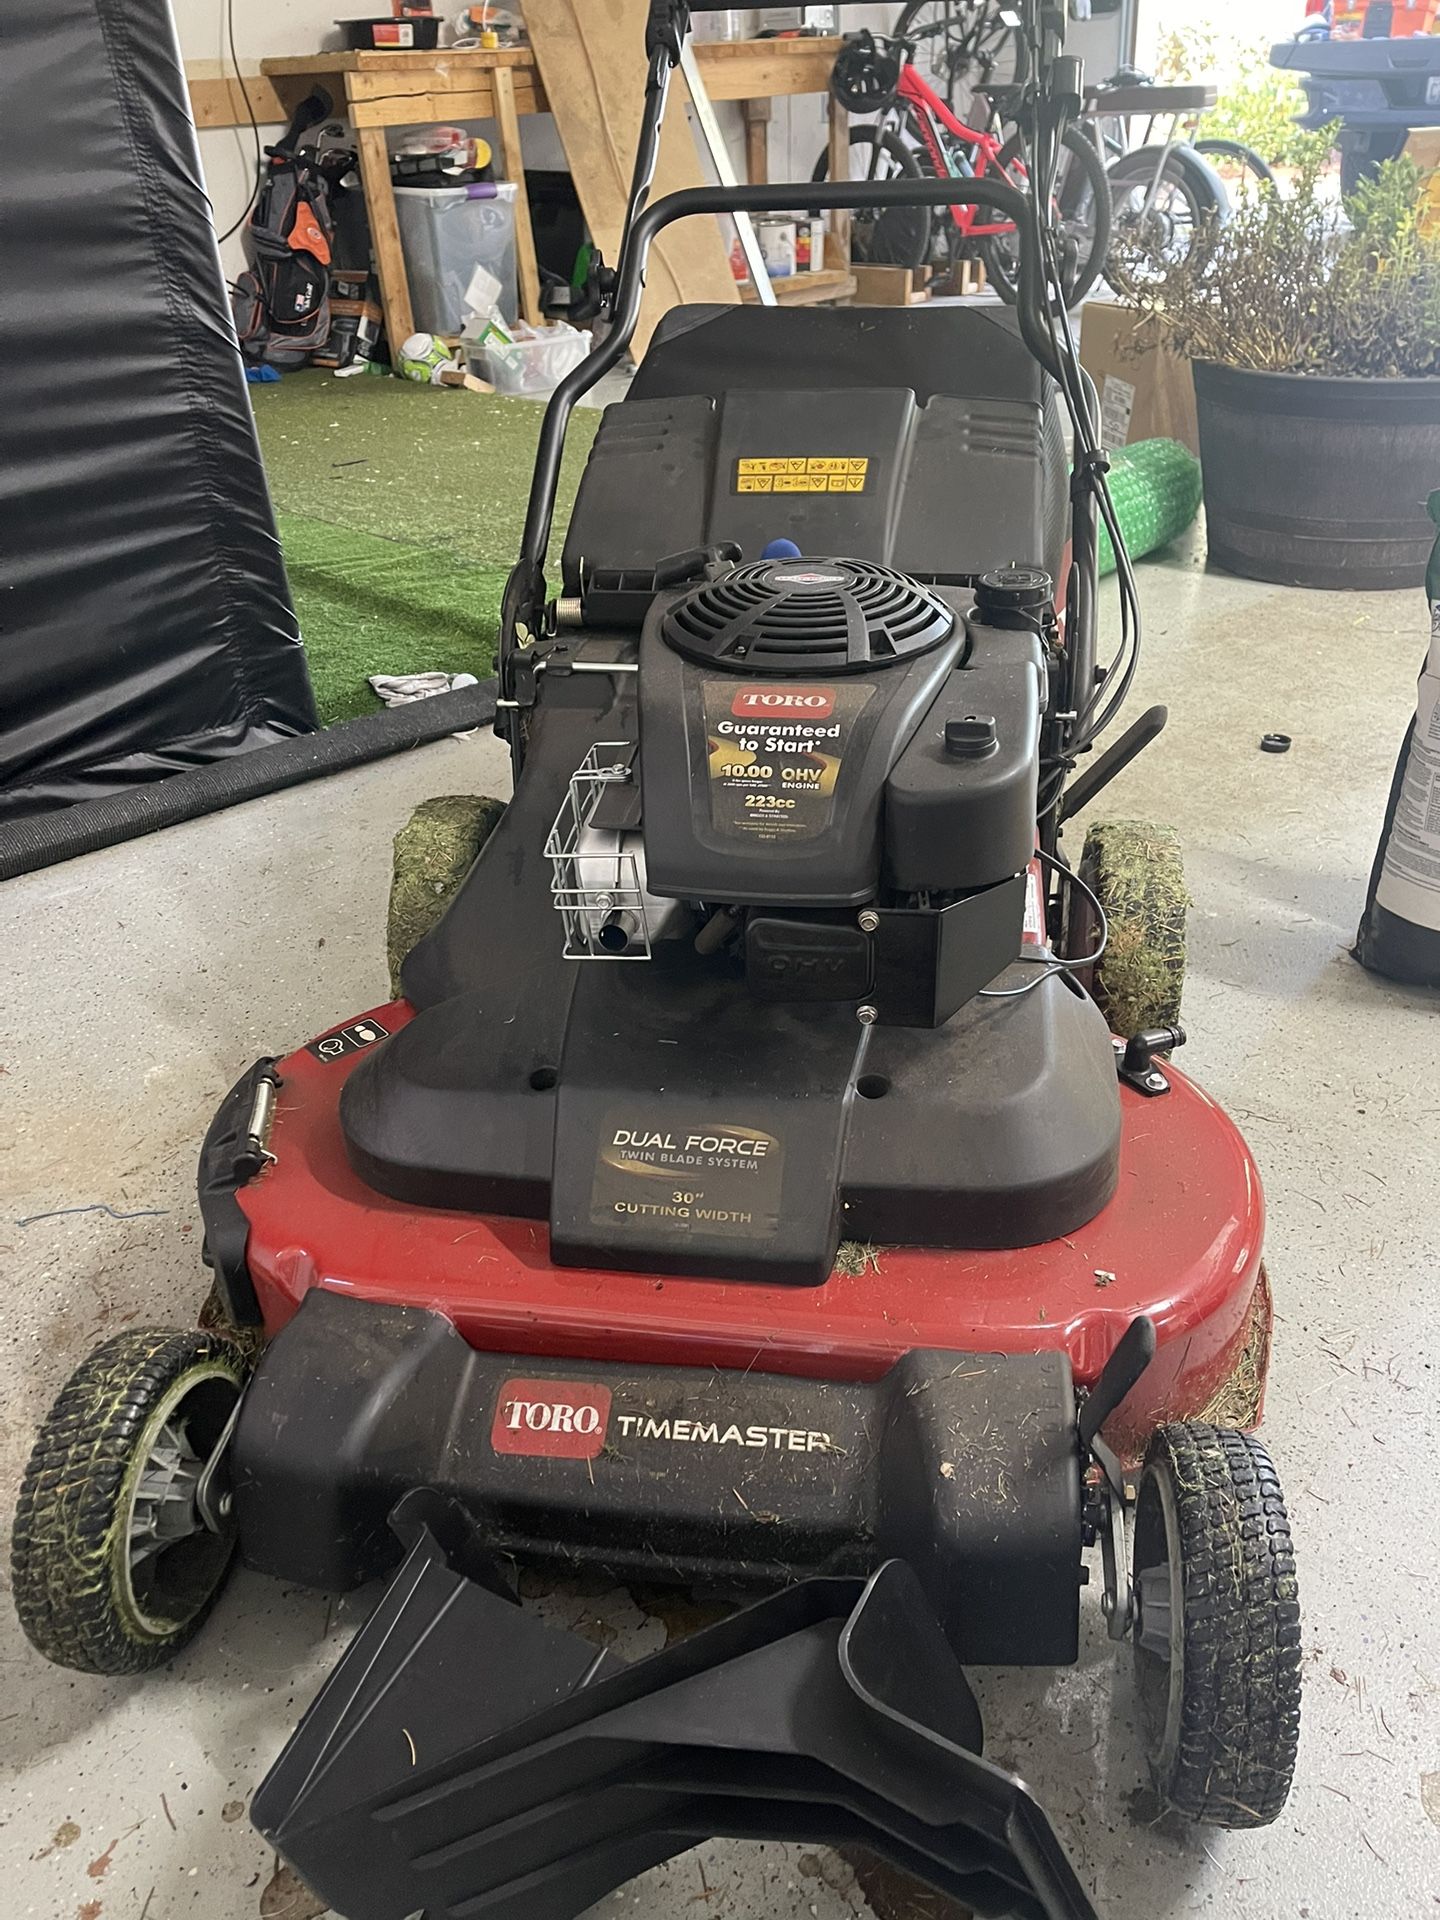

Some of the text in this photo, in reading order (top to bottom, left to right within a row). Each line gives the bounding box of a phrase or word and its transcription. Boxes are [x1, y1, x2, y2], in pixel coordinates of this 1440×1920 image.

[742, 693, 828, 708] TORO
[717, 720, 841, 738] Guaranteed
[738, 737, 759, 751] to
[720, 763, 773, 778] 10.00
[781, 767, 822, 782] OHV
[781, 781, 820, 790] ENGINE
[744, 794, 796, 809] 223cc
[612, 1129, 770, 1157] DUAL FORCE
[619, 1150, 758, 1170] TWIN BLADE SYSTEM
[613, 1202, 752, 1223] CUTTING WIDTH
[505, 1400, 831, 1452] TORO TIMEMASTER
